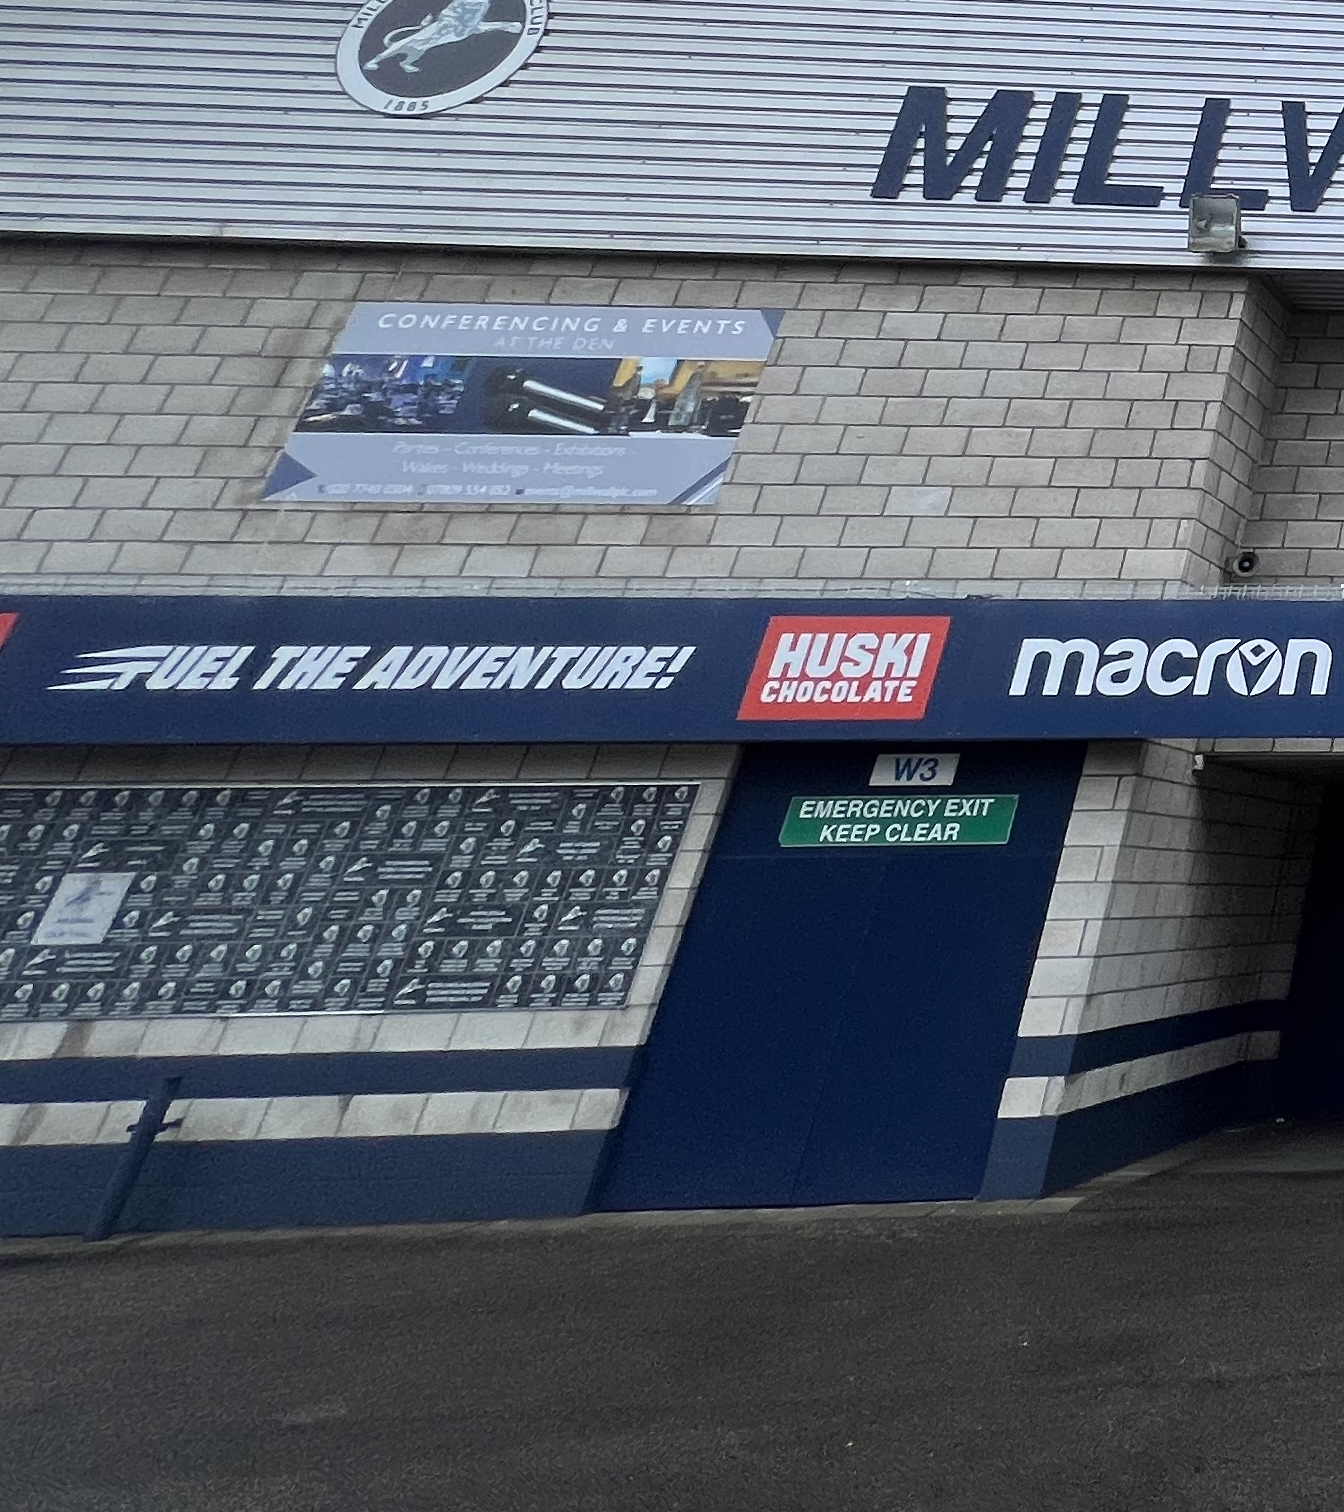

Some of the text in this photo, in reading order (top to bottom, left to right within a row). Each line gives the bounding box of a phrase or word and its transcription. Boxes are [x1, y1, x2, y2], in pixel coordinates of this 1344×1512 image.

[384, 99, 430, 112] 1885
[378, 313, 747, 335] CONFERENCING & EVENTS
[768, 633, 931, 678] HUSKI
[1009, 636, 1333, 696] macron
[47, 645, 697, 690] FUEL THE ADVENTURE!
[760, 680, 917, 703] CHOCOLATE
[894, 758, 938, 782] W3
[800, 798, 995, 819] EMERGENCY EXIT
[819, 823, 960, 842] KEEP CLEAR
